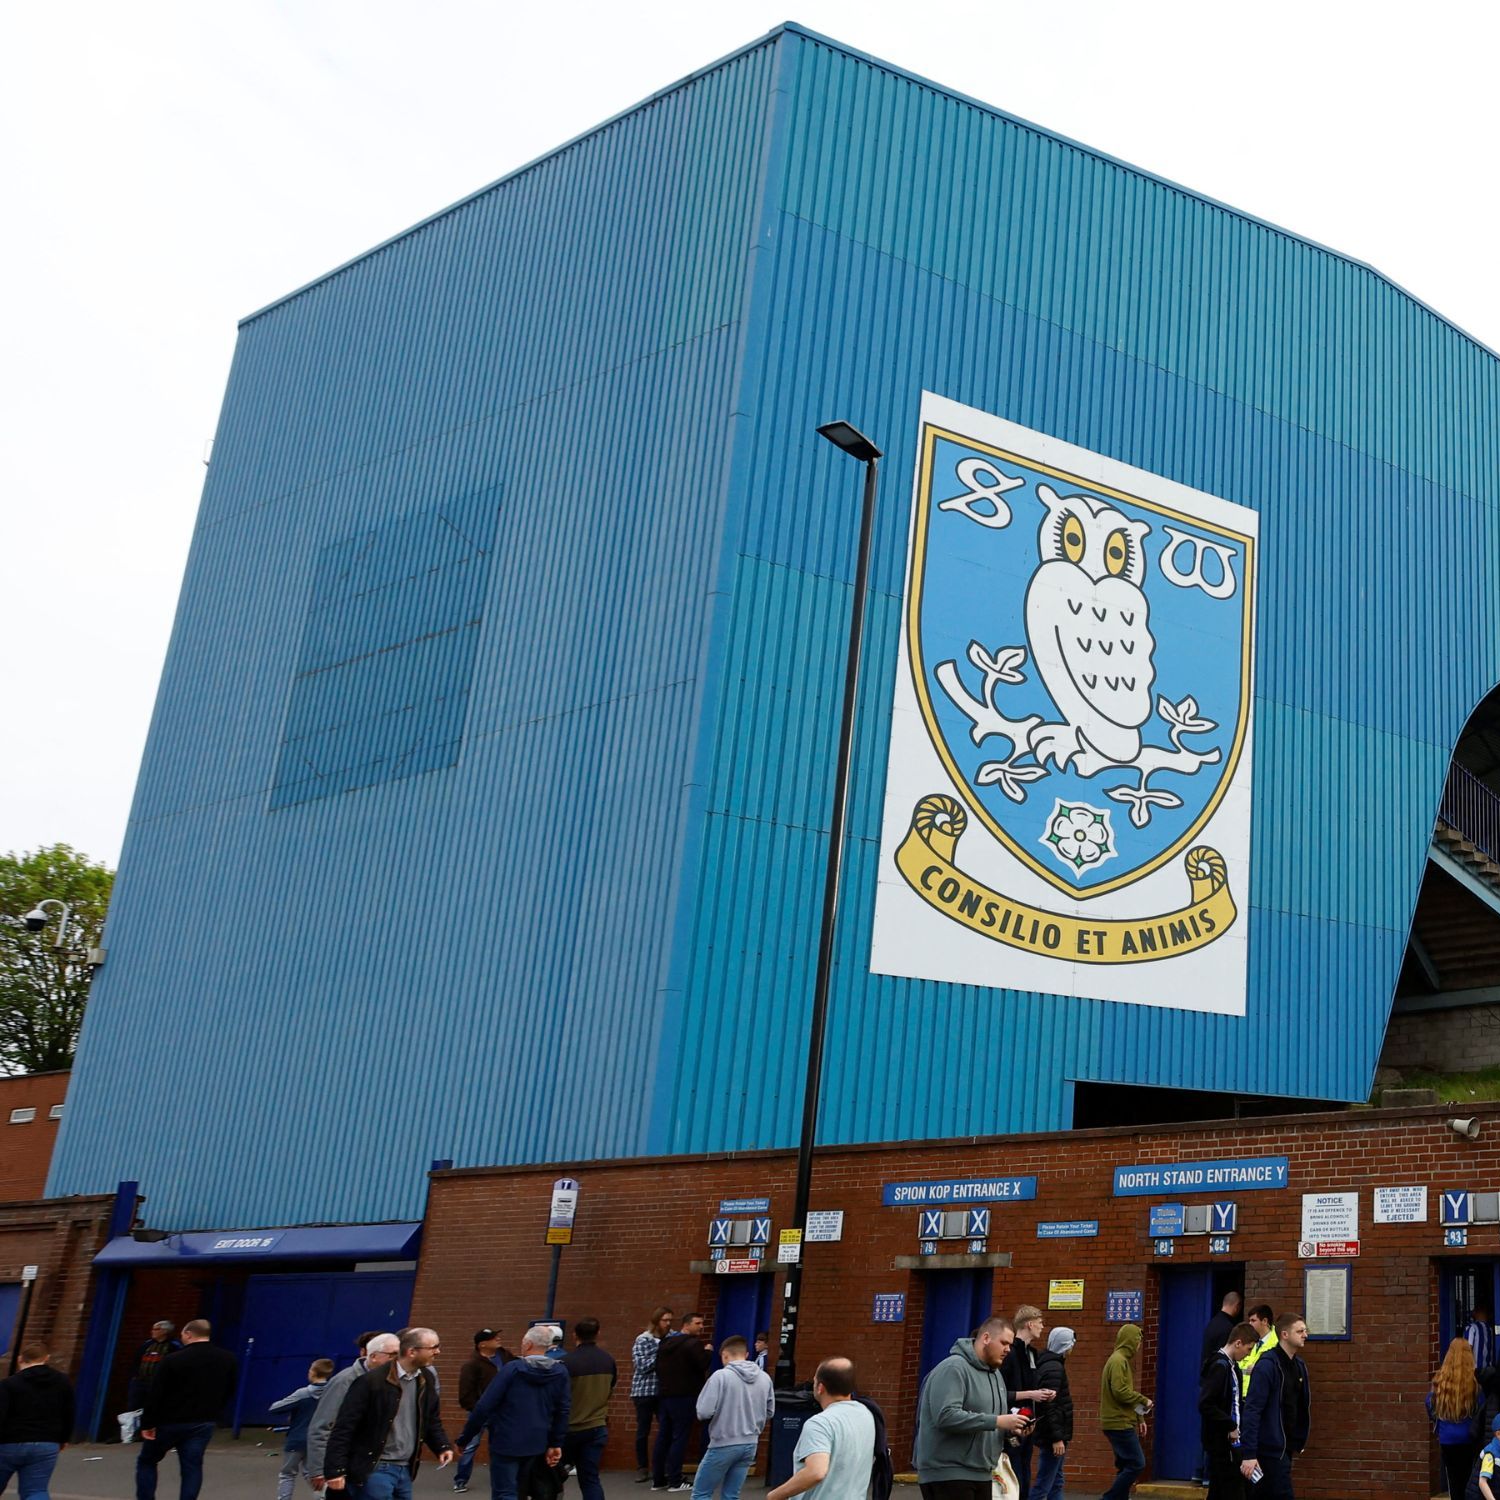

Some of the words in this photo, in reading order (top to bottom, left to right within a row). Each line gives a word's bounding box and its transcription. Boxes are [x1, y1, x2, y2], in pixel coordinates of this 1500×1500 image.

[920, 865, 1060, 949] CONSILIO
[1077, 929, 1107, 955] ET
[1122, 909, 1215, 955] ANIMIS
[1119, 1172, 1159, 1188] NORTH
[1163, 1170, 1203, 1186] STAND
[1206, 1167, 1272, 1183] ENTRANCE
[1276, 1166, 1285, 1180] Y
[895, 1186, 926, 1201] SPION
[929, 1185, 950, 1199] KOP
[953, 1182, 1010, 1198] ENTRANCE
[1013, 1182, 1021, 1196] X
[1215, 1204, 1233, 1228] Y
[1446, 1194, 1465, 1219] Y
[714, 1221, 729, 1241] X
[754, 1220, 769, 1240] X
[925, 1212, 940, 1234] X
[971, 1210, 986, 1232] X
[925, 1242, 933, 1253] 79
[972, 1240, 982, 1252] 80
